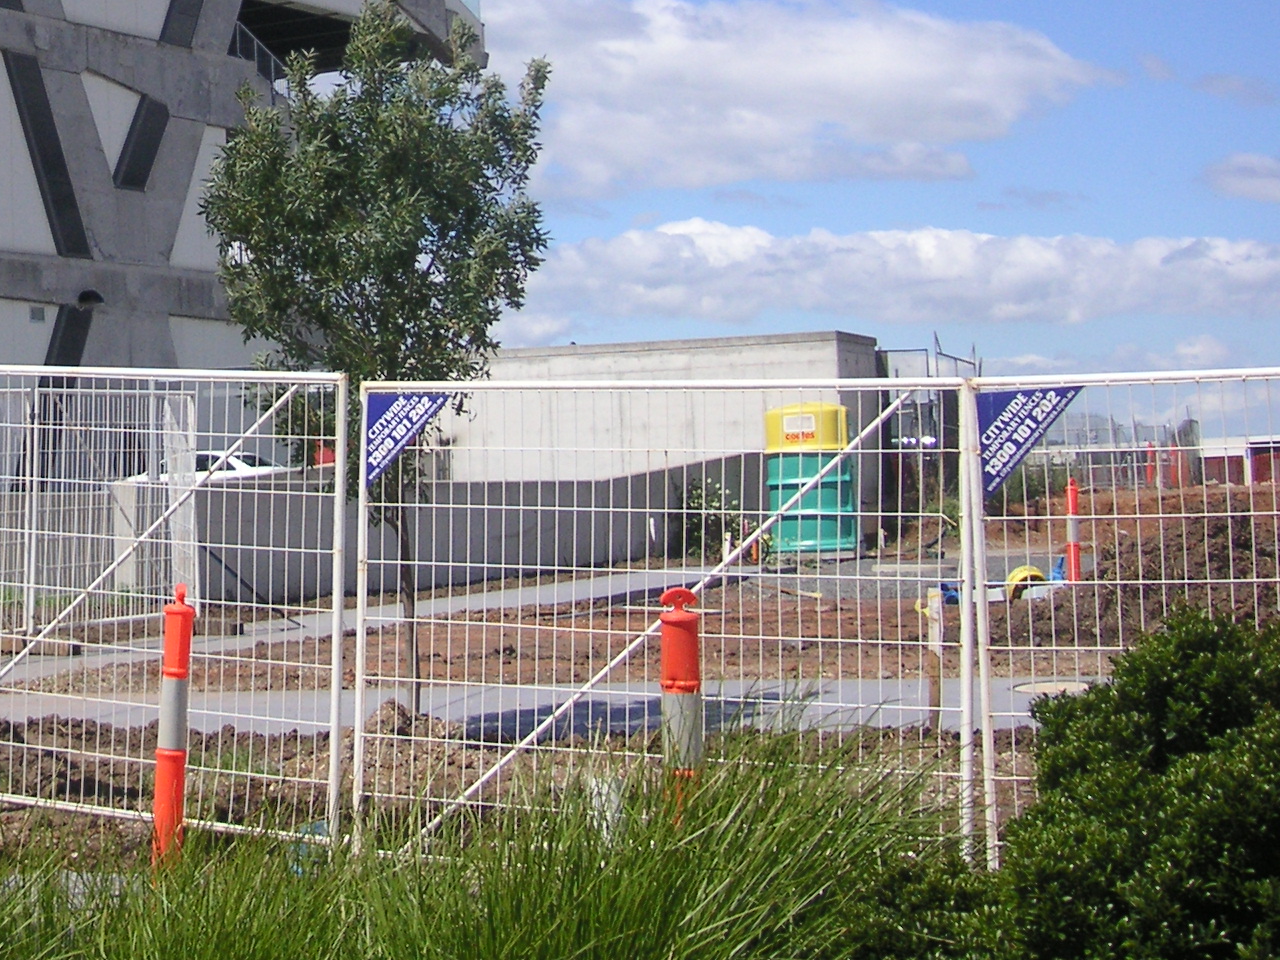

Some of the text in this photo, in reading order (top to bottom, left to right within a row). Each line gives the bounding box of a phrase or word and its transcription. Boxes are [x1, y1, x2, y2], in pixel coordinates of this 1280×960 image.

[368, 395, 407, 439] CITYWIDE
[368, 395, 419, 452] TEMPORARY FENCES
[368, 396, 432, 466] 1300 101 202
[981, 392, 1028, 445] CITYWIDE
[982, 391, 1044, 460] TEMPORARY FENCES
[984, 390, 1061, 476] 1300 101 202
